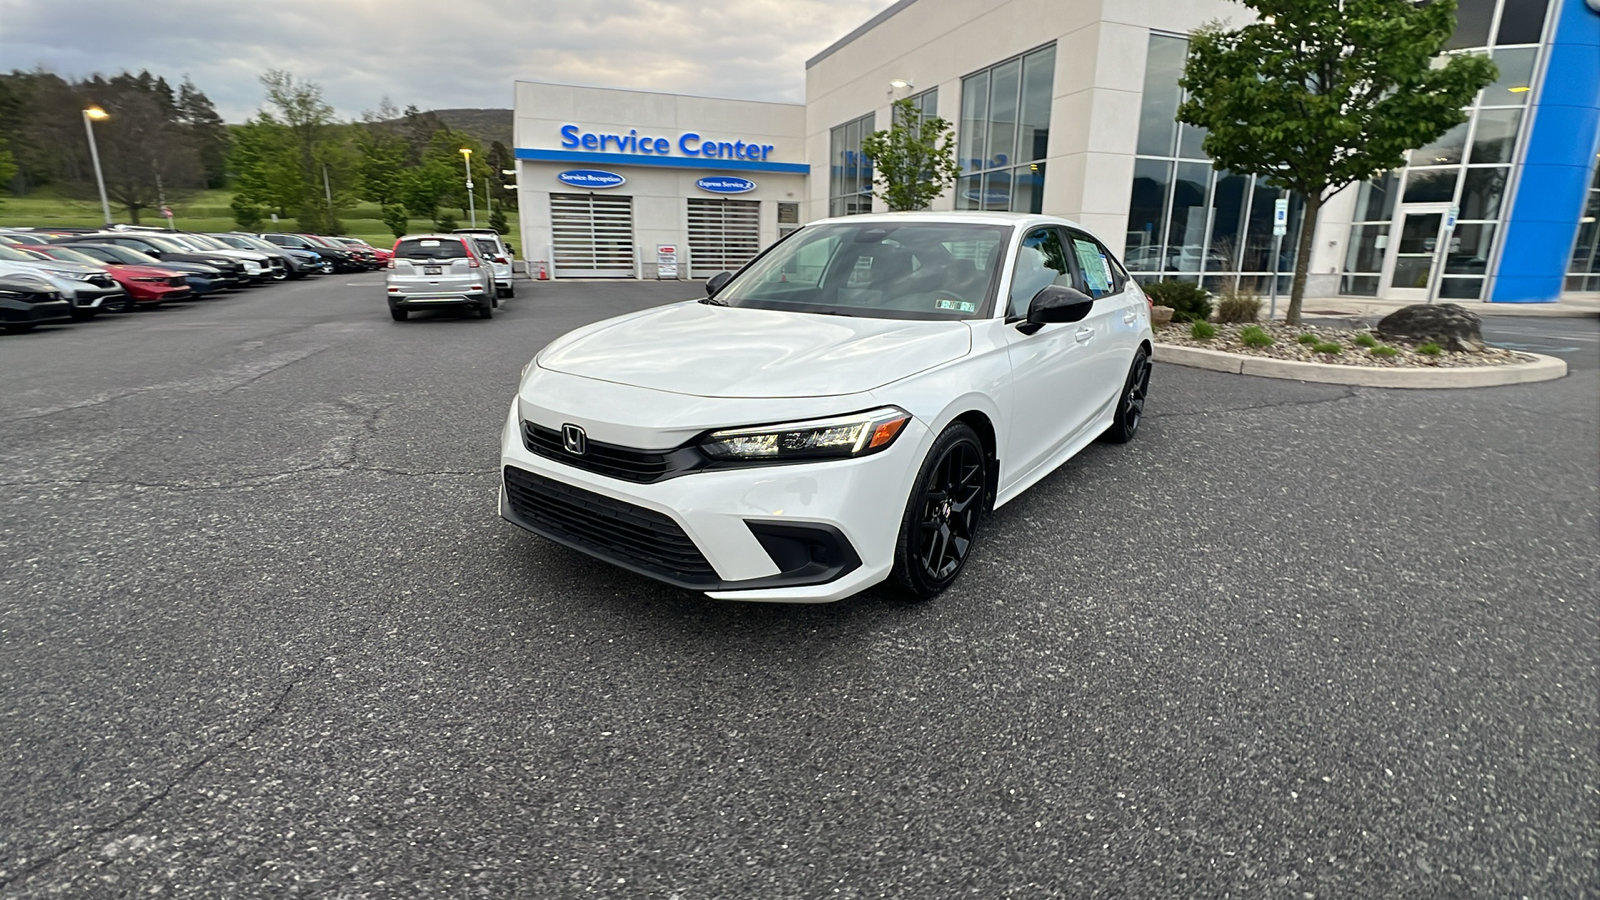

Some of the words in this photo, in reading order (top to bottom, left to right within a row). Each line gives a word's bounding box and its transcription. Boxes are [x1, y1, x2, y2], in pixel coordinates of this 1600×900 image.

[561, 124, 670, 155] Service
[678, 132, 774, 160] Center
[561, 173, 586, 181] Service
[587, 174, 622, 184] Reception
[698, 180, 721, 188] Express
